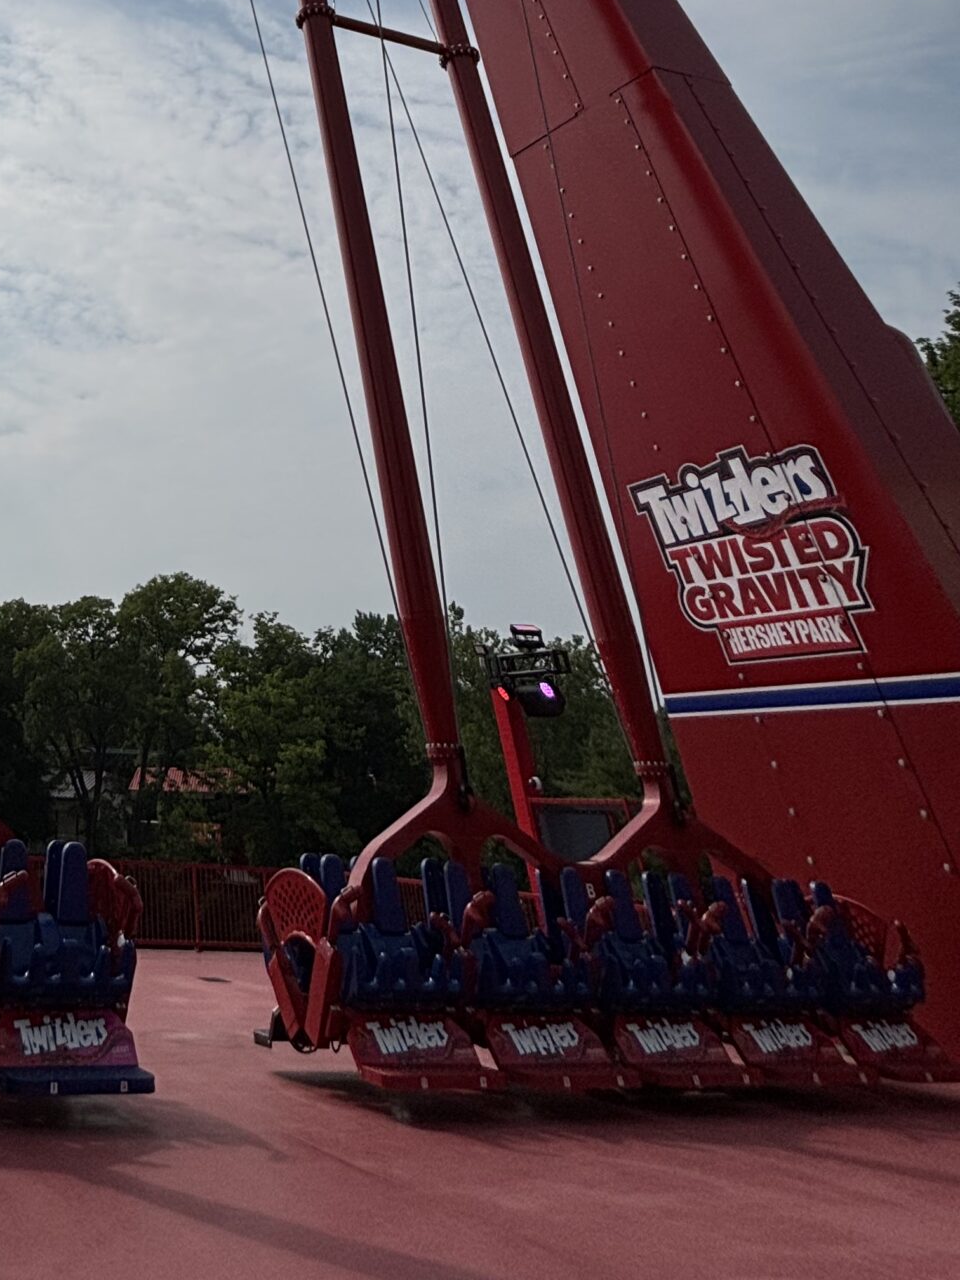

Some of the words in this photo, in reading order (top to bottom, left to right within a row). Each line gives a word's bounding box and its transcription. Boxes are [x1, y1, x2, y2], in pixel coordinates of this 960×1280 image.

[637, 455, 829, 546] Twizzlers
[667, 520, 850, 585] TWISTED
[684, 561, 859, 621] GRAVITY
[729, 614, 851, 655] HERSHEYPARK
[585, 883, 597, 900] B
[13, 1012, 108, 1055] Twizzlers
